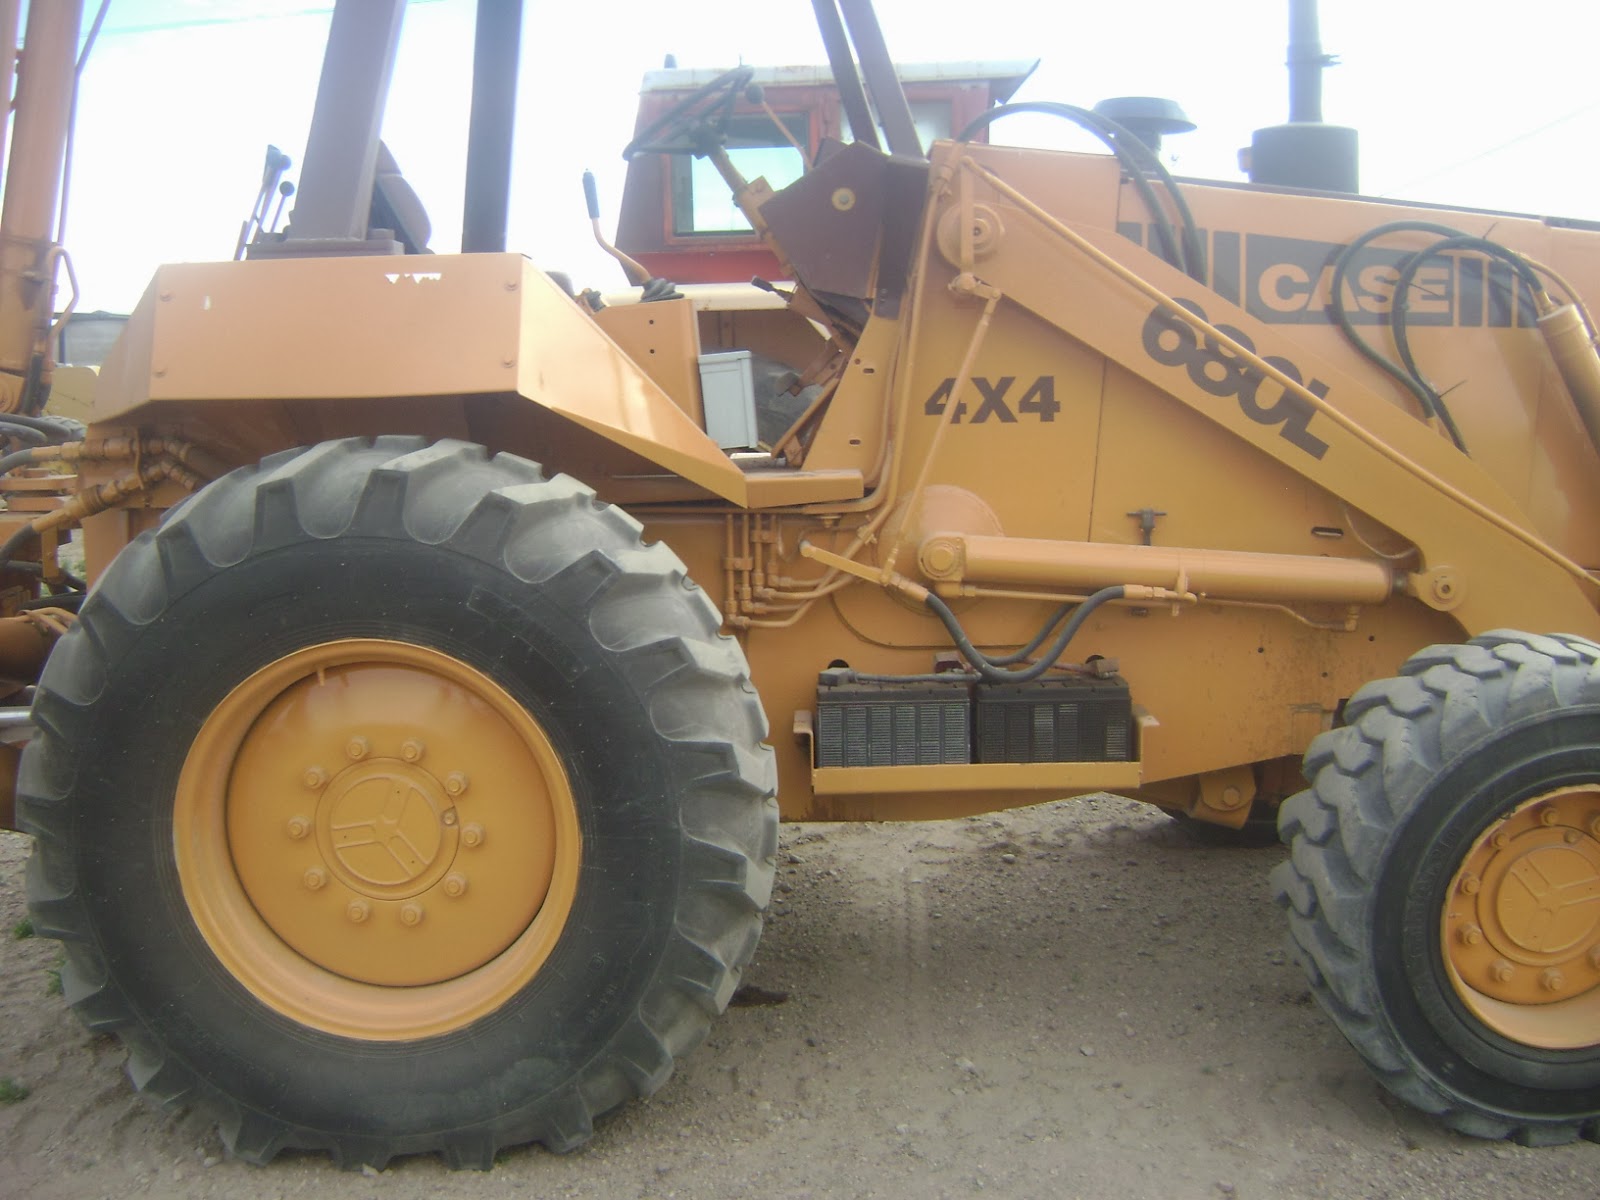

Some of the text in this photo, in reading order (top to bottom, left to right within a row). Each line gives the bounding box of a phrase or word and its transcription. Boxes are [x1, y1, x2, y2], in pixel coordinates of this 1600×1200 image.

[1258, 263, 1450, 313] CASE
[924, 375, 1061, 424] 4X4
[1142, 297, 1330, 461] 680L
